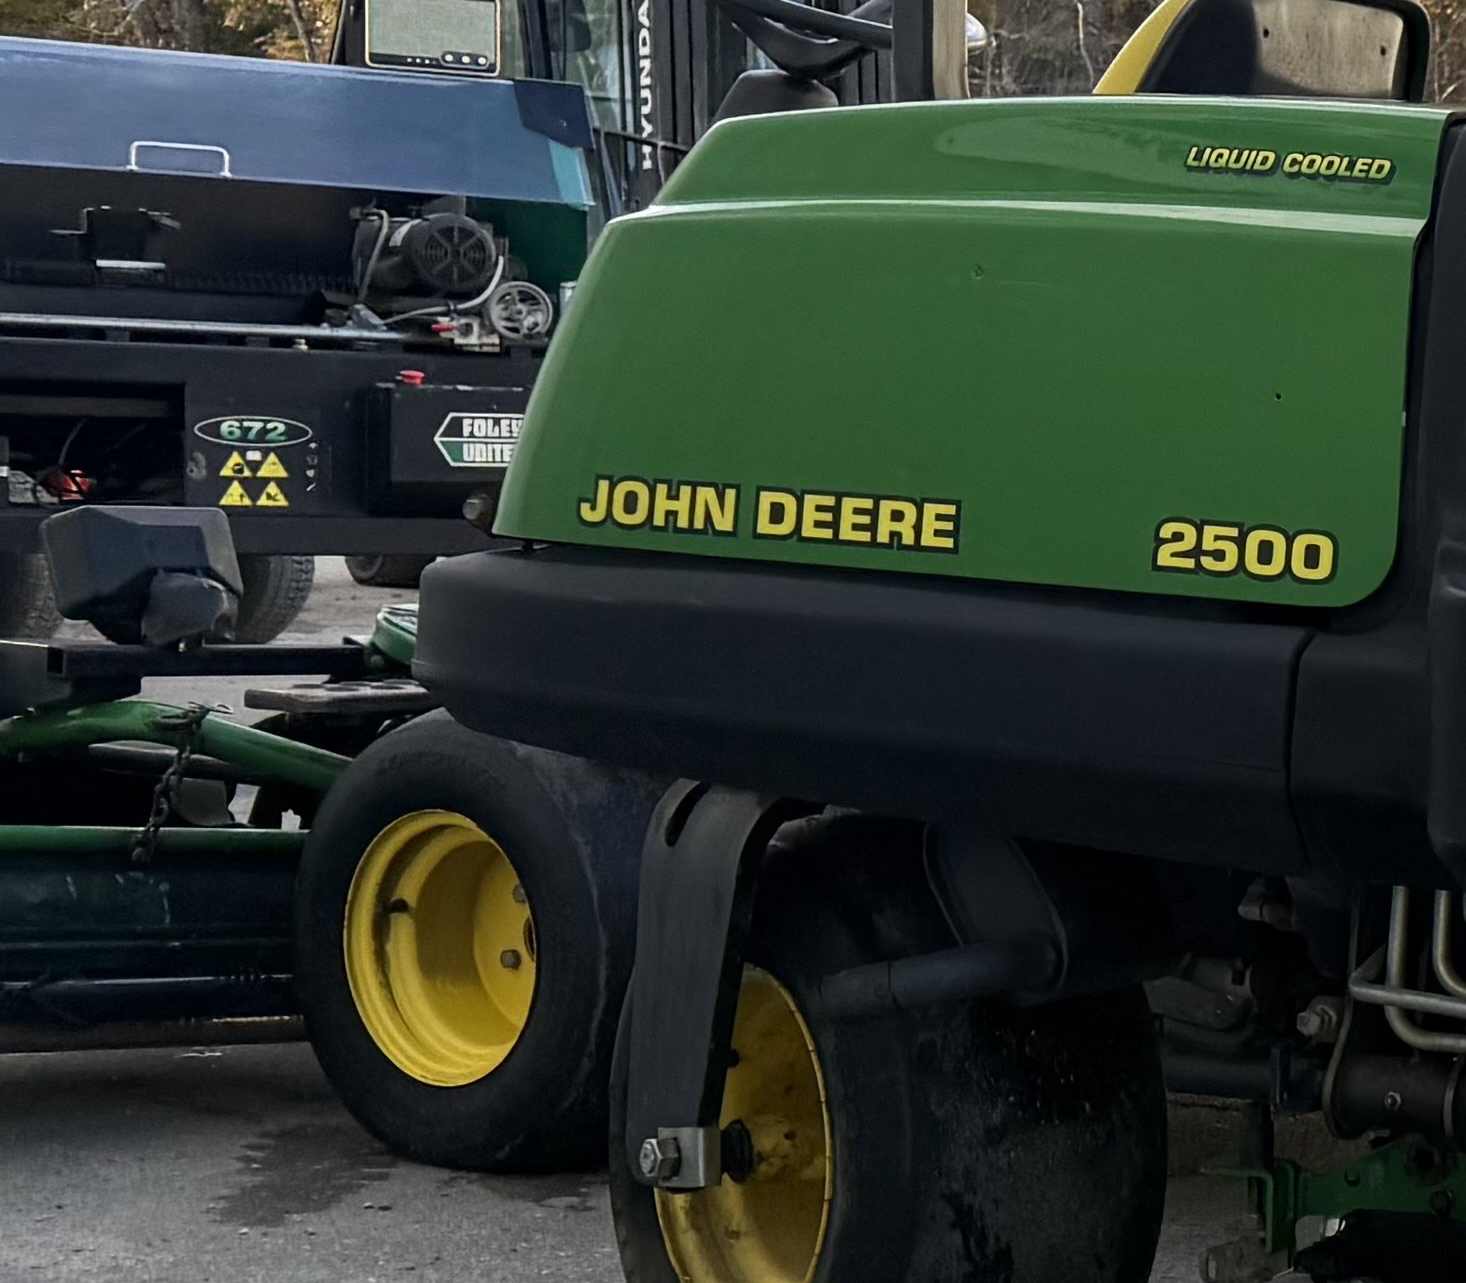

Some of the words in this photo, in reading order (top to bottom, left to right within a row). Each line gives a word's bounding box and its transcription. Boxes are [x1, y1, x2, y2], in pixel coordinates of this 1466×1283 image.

[1186, 146, 1277, 171] LIQUID
[1283, 153, 1392, 180] COOLED
[219, 420, 288, 441] 672
[462, 418, 524, 438] FOLEY
[462, 443, 514, 463] UNITE
[579, 478, 737, 532] JOHN
[756, 490, 957, 549] DEERE
[1156, 521, 1335, 580] 2500
